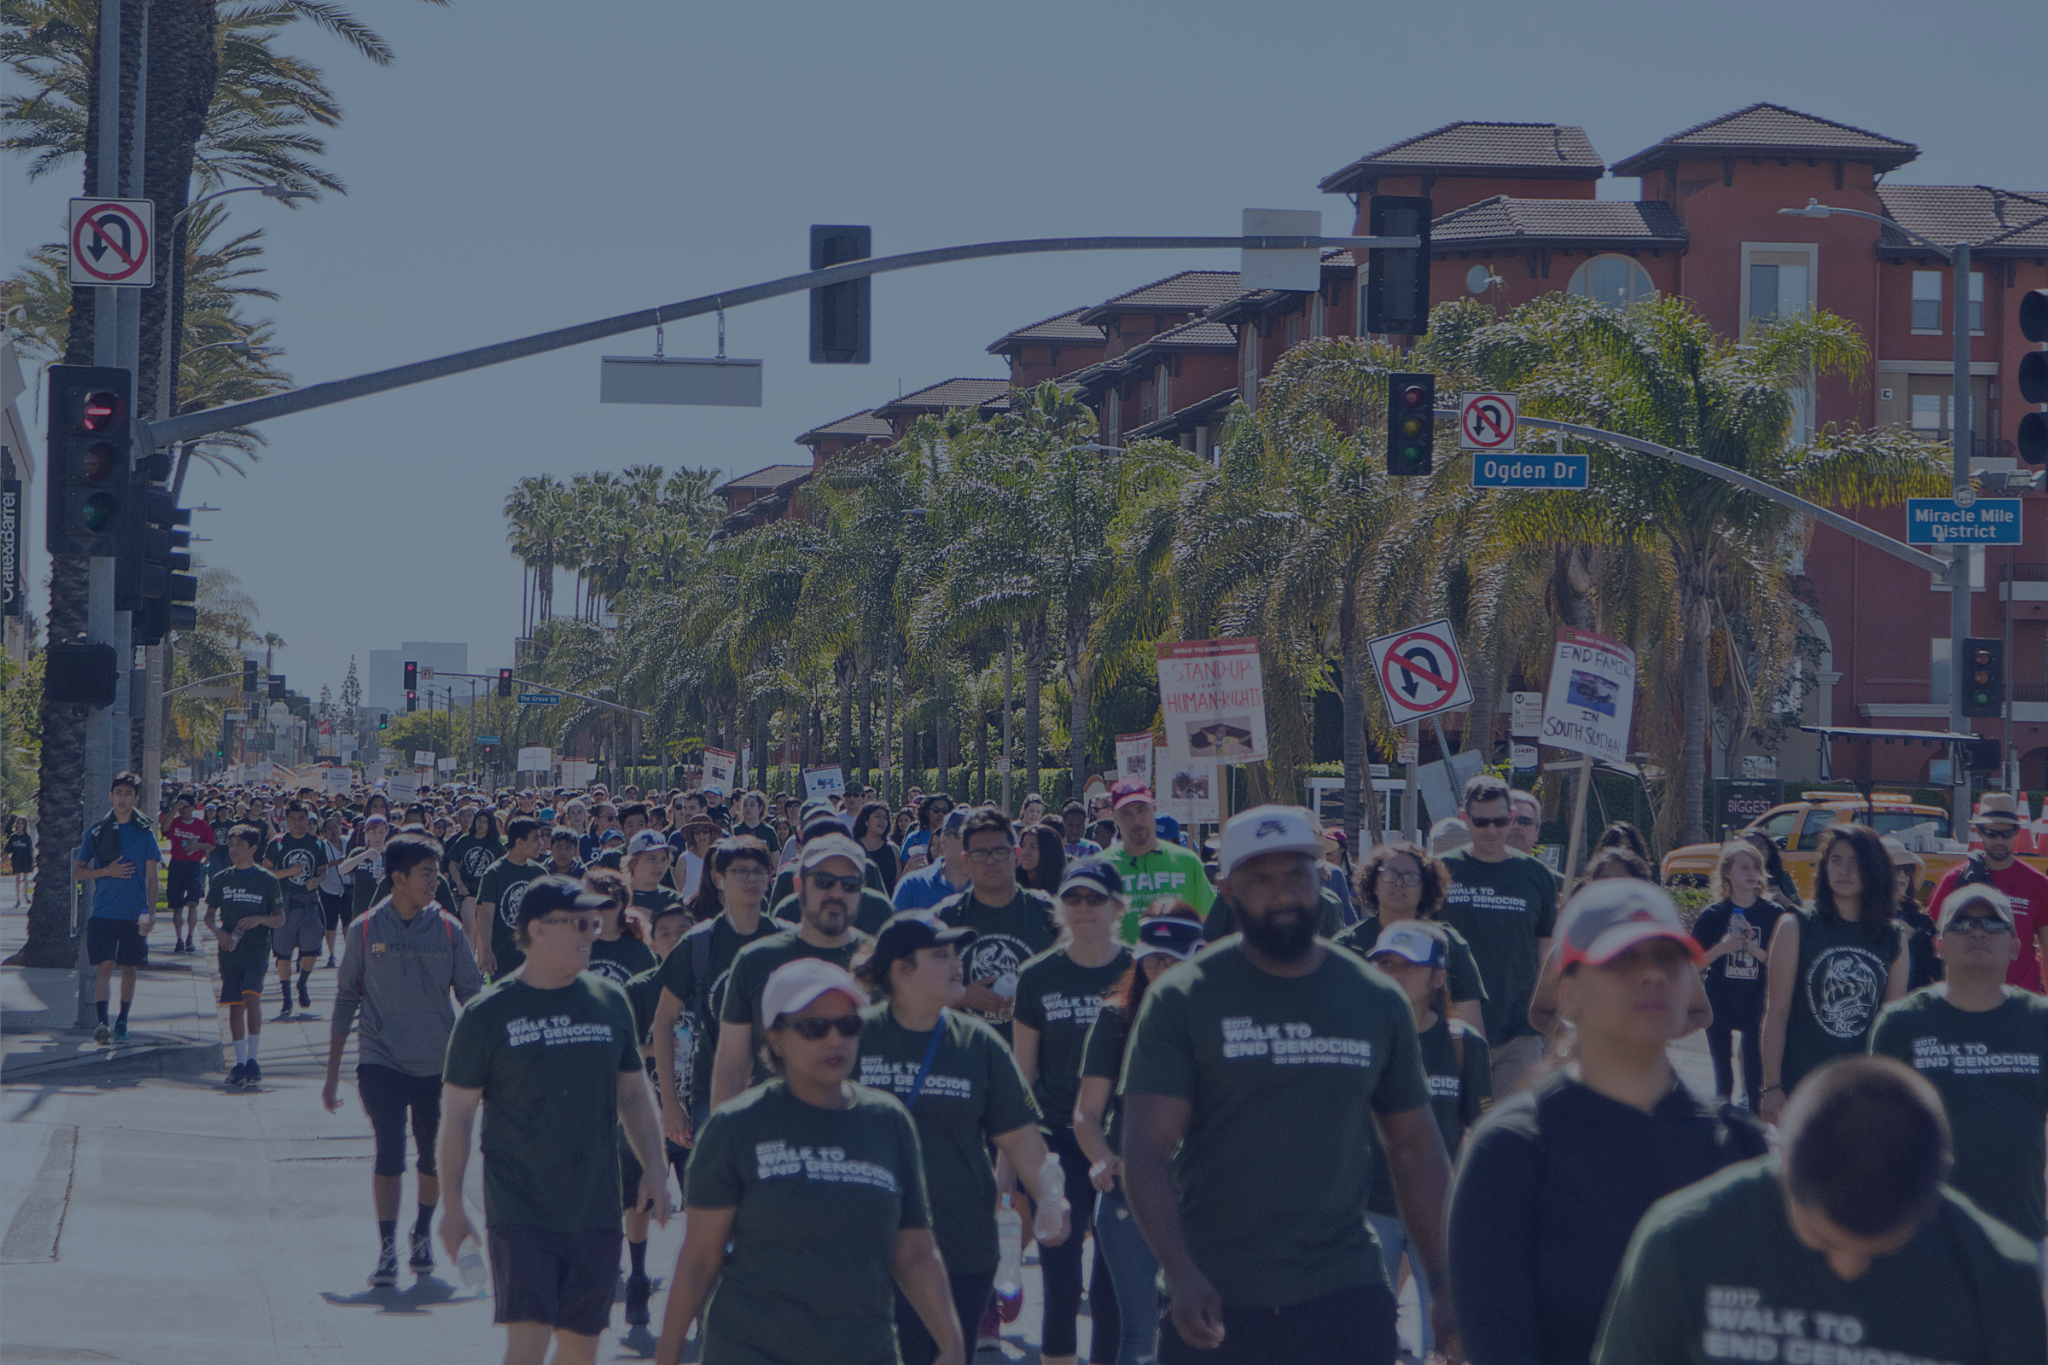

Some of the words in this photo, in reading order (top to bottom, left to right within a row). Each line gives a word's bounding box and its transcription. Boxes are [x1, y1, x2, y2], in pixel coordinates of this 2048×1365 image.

[1484, 461, 1546, 483] Ogden
[1553, 462, 1577, 479] Dr
[1915, 509, 1976, 523] Miracle
[1980, 509, 2014, 522] Mile
[1932, 524, 1997, 539] District
[1220, 643, 1256, 652] GENOCIDE
[1576, 635, 1594, 643] WALK
[1596, 639, 1605, 647] TO
[1560, 645, 1593, 663] END
[1595, 652, 1632, 681] FAMINE
[1171, 660, 1226, 682] STAND
[1229, 659, 1251, 681] UP
[532, 695, 548, 703] Grove
[1166, 691, 1219, 713] HUMAN
[1221, 688, 1261, 710] RIGHTS
[1581, 710, 1599, 723] IN
[1543, 715, 1584, 741] SOUTH
[1584, 726, 1621, 755] SUDAN
[1728, 800, 1772, 813] BIGGEST
[1121, 871, 1186, 892] TAFF
[1448, 888, 1478, 896] WALK
[1480, 887, 1495, 896] TO
[1448, 895, 1471, 904] END
[1473, 895, 1527, 907] GENOCIDE
[2008, 896, 2029, 906] CIDE
[1728, 966, 1757, 977] BOBEY
[1043, 998, 1081, 1011] WALK
[1084, 997, 1103, 1006] TO
[1046, 1009, 1072, 1021] END
[1828, 1006, 1865, 1021] DRAGONS
[508, 1019, 549, 1036] WALK
[550, 1016, 571, 1027] TO
[1222, 1019, 1252, 1030] 2017
[509, 1032, 541, 1047] END
[543, 1024, 612, 1039] GENOCIDE
[1223, 1026, 1280, 1042] WALK
[1284, 1024, 1312, 1039] TO
[1223, 1041, 1269, 1058] END
[1271, 1038, 1371, 1057] GENOCIDE
[1914, 1038, 1938, 1047] 2017
[1915, 1045, 1961, 1057] WALK
[1964, 1044, 1988, 1056] TO
[860, 1056, 884, 1065] 2017
[1274, 1056, 1286, 1065] DO
[1288, 1056, 1306, 1065] NOT
[1307, 1055, 1339, 1064] STAND
[1340, 1056, 1360, 1065] IDLY
[1916, 1057, 1949, 1069] END
[1954, 1055, 2040, 1067] GENOCIDE
[860, 1064, 903, 1075] WALK
[860, 1074, 892, 1086] END
[894, 1074, 972, 1092] GEOCIDE
[756, 1141, 786, 1156] 2017
[757, 1150, 814, 1167] WALK
[817, 1148, 845, 1161] TO
[758, 1162, 801, 1180] END
[821, 1173, 841, 1181] NOT
[1707, 1286, 1760, 1308] 2017
[1706, 1307, 1806, 1337] WALK
[1813, 1313, 1863, 1345] TO
[1703, 1331, 1779, 1362] END
[1785, 1340, 1962, 1365] GENO
